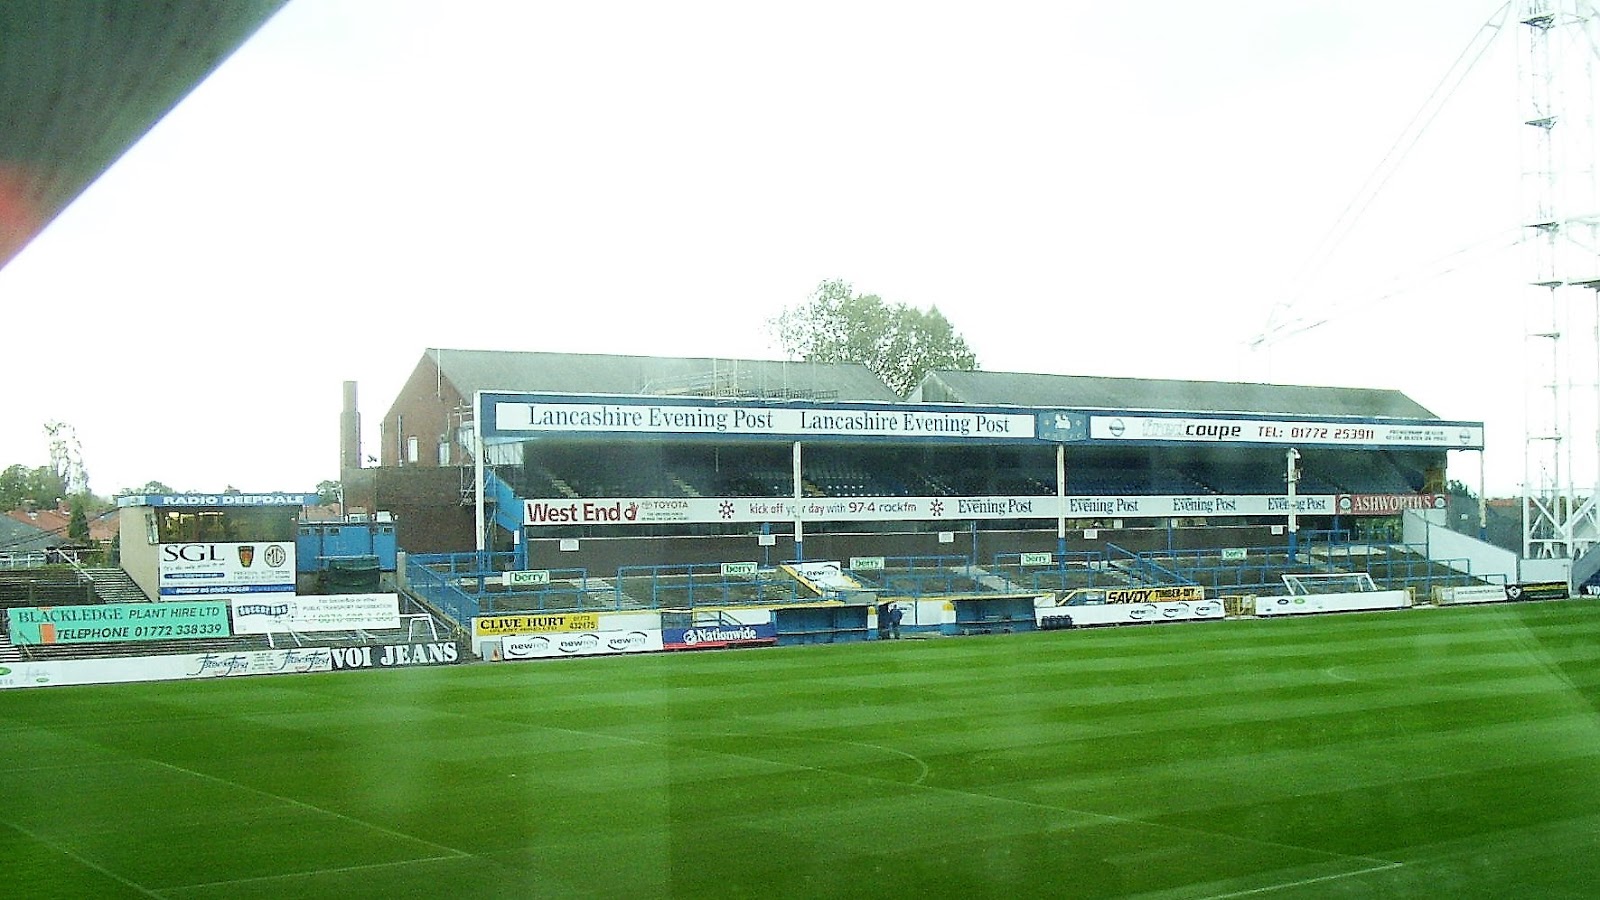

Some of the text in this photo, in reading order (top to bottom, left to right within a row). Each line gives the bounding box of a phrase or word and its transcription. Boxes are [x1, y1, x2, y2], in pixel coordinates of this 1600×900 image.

[528, 405, 774, 431] Lancashire Evening Post
[799, 411, 1010, 434] Lancashire Evening Post
[1185, 423, 1242, 440] coupe
[1257, 426, 1284, 438] TEL:
[1290, 427, 1328, 439] 01772
[162, 494, 305, 505] RADIO DEEPDALE
[654, 501, 689, 509] TOYOTA
[1069, 498, 1139, 514] Evening Post
[1173, 497, 1237, 514] Evening Post
[1307, 497, 1326, 511] Post
[527, 500, 621, 522] West End
[749, 502, 769, 514] kick
[770, 502, 784, 514] off
[786, 504, 806, 517] yor
[808, 502, 825, 517] day
[826, 502, 846, 514] with
[957, 498, 1033, 518] Evening Post
[163, 544, 225, 563] SGL
[1023, 553, 1048, 565] berry
[726, 564, 753, 575] berry
[514, 572, 545, 584] berry
[1107, 589, 1153, 604] SAVOY
[18, 606, 220, 623] BLACKLEDGE PLANT HIRE LTD
[480, 618, 522, 630] CLIVE
[527, 616, 566, 627] HURT
[56, 627, 130, 640] TELEPHONE
[134, 626, 173, 637] 01772
[695, 627, 757, 642] Nationwide
[330, 648, 373, 669] VOI
[380, 641, 459, 666] JEANS
